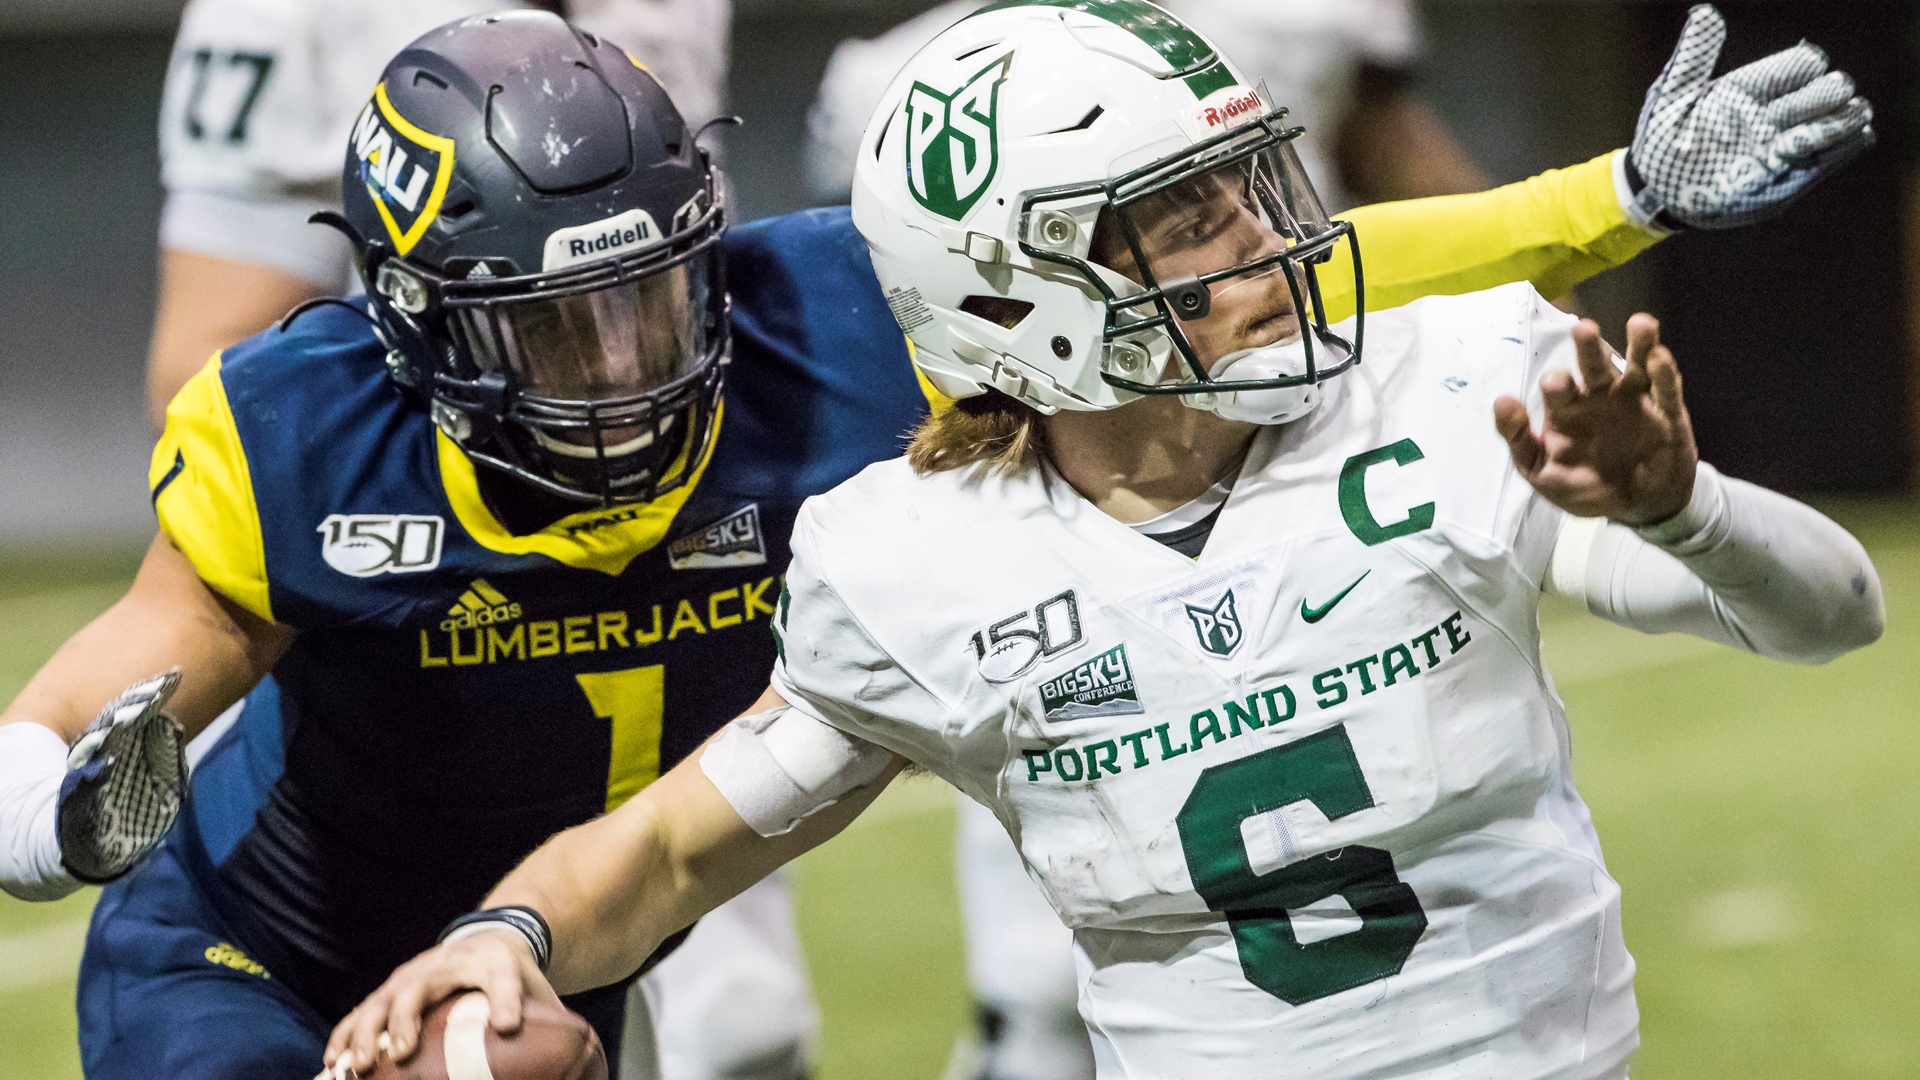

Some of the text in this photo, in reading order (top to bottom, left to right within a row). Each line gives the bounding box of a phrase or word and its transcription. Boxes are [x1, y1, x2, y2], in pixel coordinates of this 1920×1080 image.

[351, 102, 430, 213] NAU
[910, 60, 1005, 202] PS
[569, 221, 650, 257] Riddell
[1337, 437, 1435, 547] C
[323, 517, 441, 574] 150
[420, 573, 786, 669] LUMBERJACK
[439, 602, 523, 632] adidas
[969, 587, 1084, 680] 150
[1189, 594, 1240, 651] PS
[575, 663, 665, 815] 1
[1021, 610, 1472, 783] PORTLAND STATE
[1073, 680, 1134, 703] CONFERENCE
[1174, 721, 1429, 1008] 6
